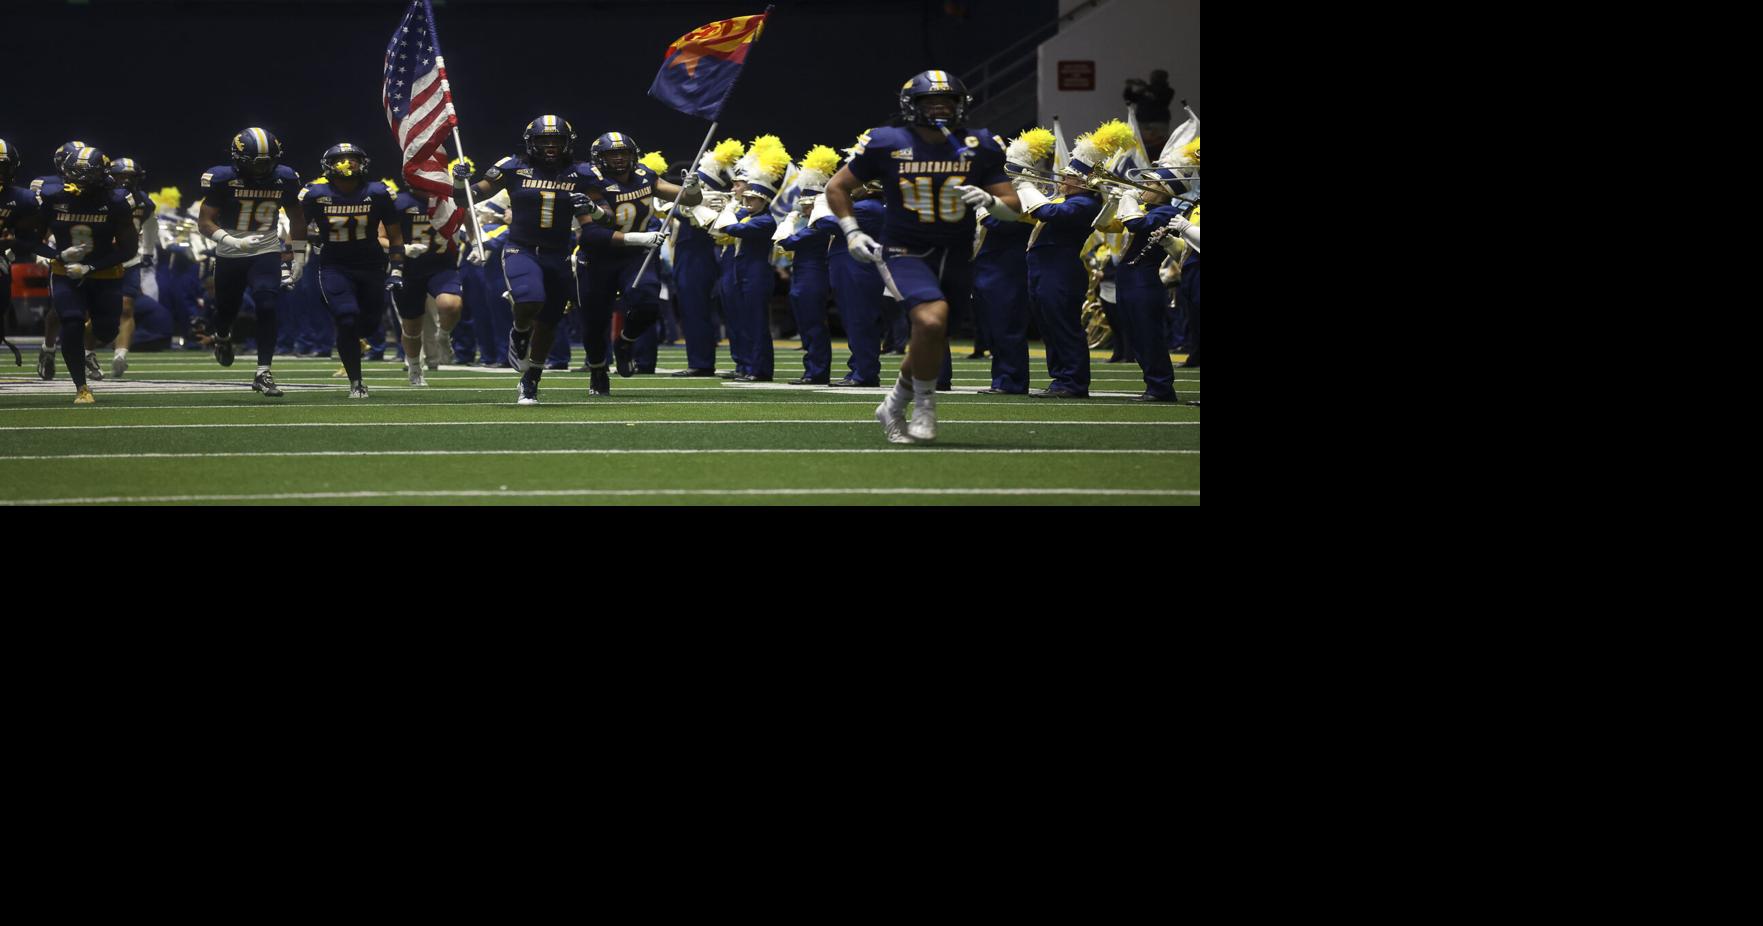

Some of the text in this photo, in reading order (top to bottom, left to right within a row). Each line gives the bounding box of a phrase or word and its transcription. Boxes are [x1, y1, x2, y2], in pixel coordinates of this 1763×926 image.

[898, 161, 972, 174] LUMBERJACKS
[234, 188, 284, 198] LUMBERJACKS
[522, 178, 576, 191] LUMBERJACKS
[323, 204, 372, 214] LUMBERJACKS
[539, 190, 556, 229] 1
[899, 175, 966, 224] 46
[236, 199, 278, 232] 19
[327, 214, 369, 242] 31
